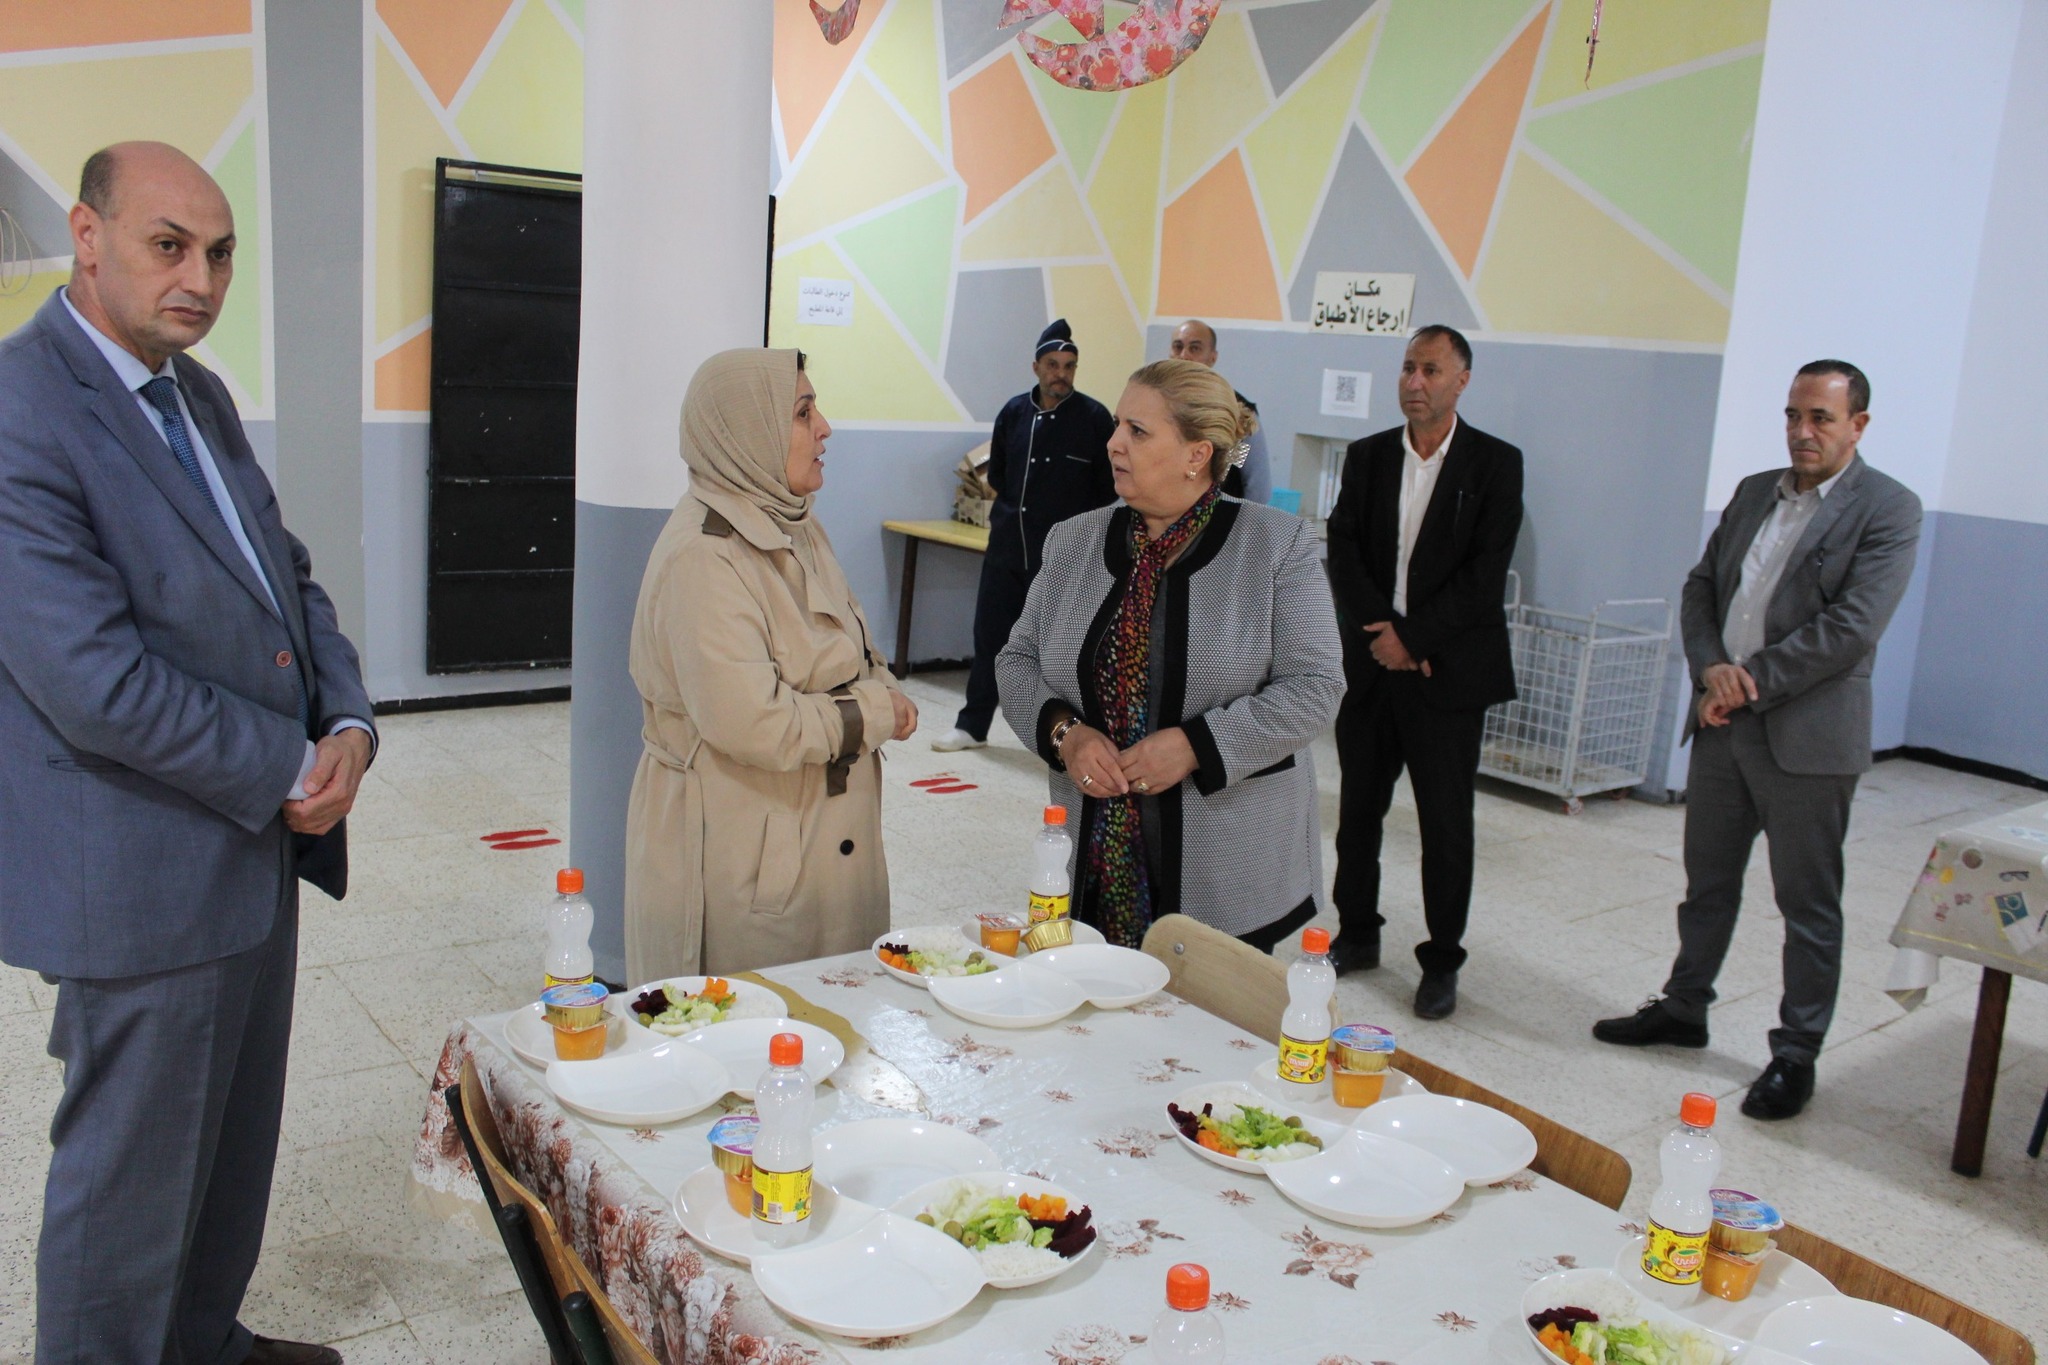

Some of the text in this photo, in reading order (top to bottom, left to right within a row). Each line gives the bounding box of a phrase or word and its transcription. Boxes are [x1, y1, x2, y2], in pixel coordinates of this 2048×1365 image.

[1344, 279, 1381, 301] مكان
[1314, 300, 1405, 333] إرجاع الأطباق
